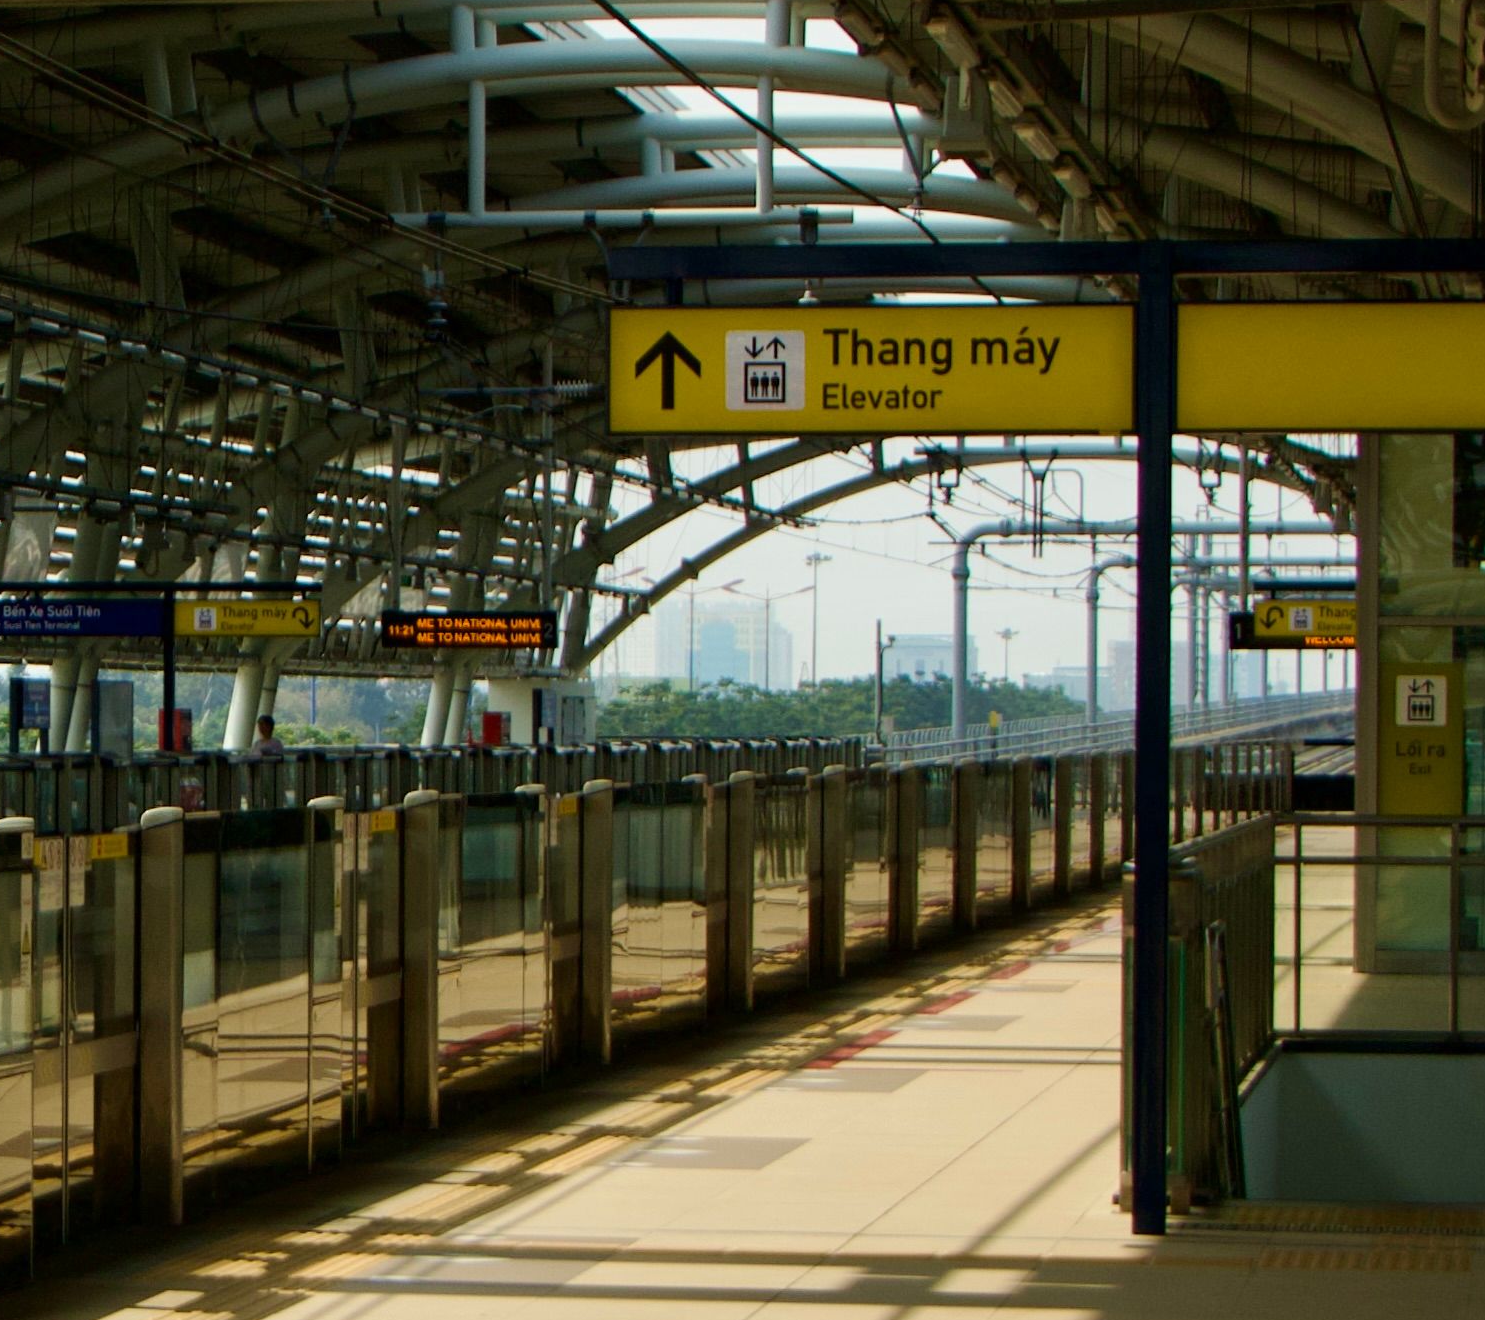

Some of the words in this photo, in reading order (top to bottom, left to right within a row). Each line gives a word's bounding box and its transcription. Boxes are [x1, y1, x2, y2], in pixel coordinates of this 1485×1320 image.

[823, 328, 954, 375] Thang
[970, 326, 1061, 375] máy
[822, 382, 943, 410] Elevator
[29, 605, 44, 618] Xe
[221, 606, 259, 621] Thang
[437, 617, 454, 628] TO
[455, 617, 508, 629] NATIONAL
[437, 631, 454, 642] TO
[455, 631, 508, 643] NATIONAL
[543, 622, 555, 639] 2
[1428, 744, 1445, 758] ra
